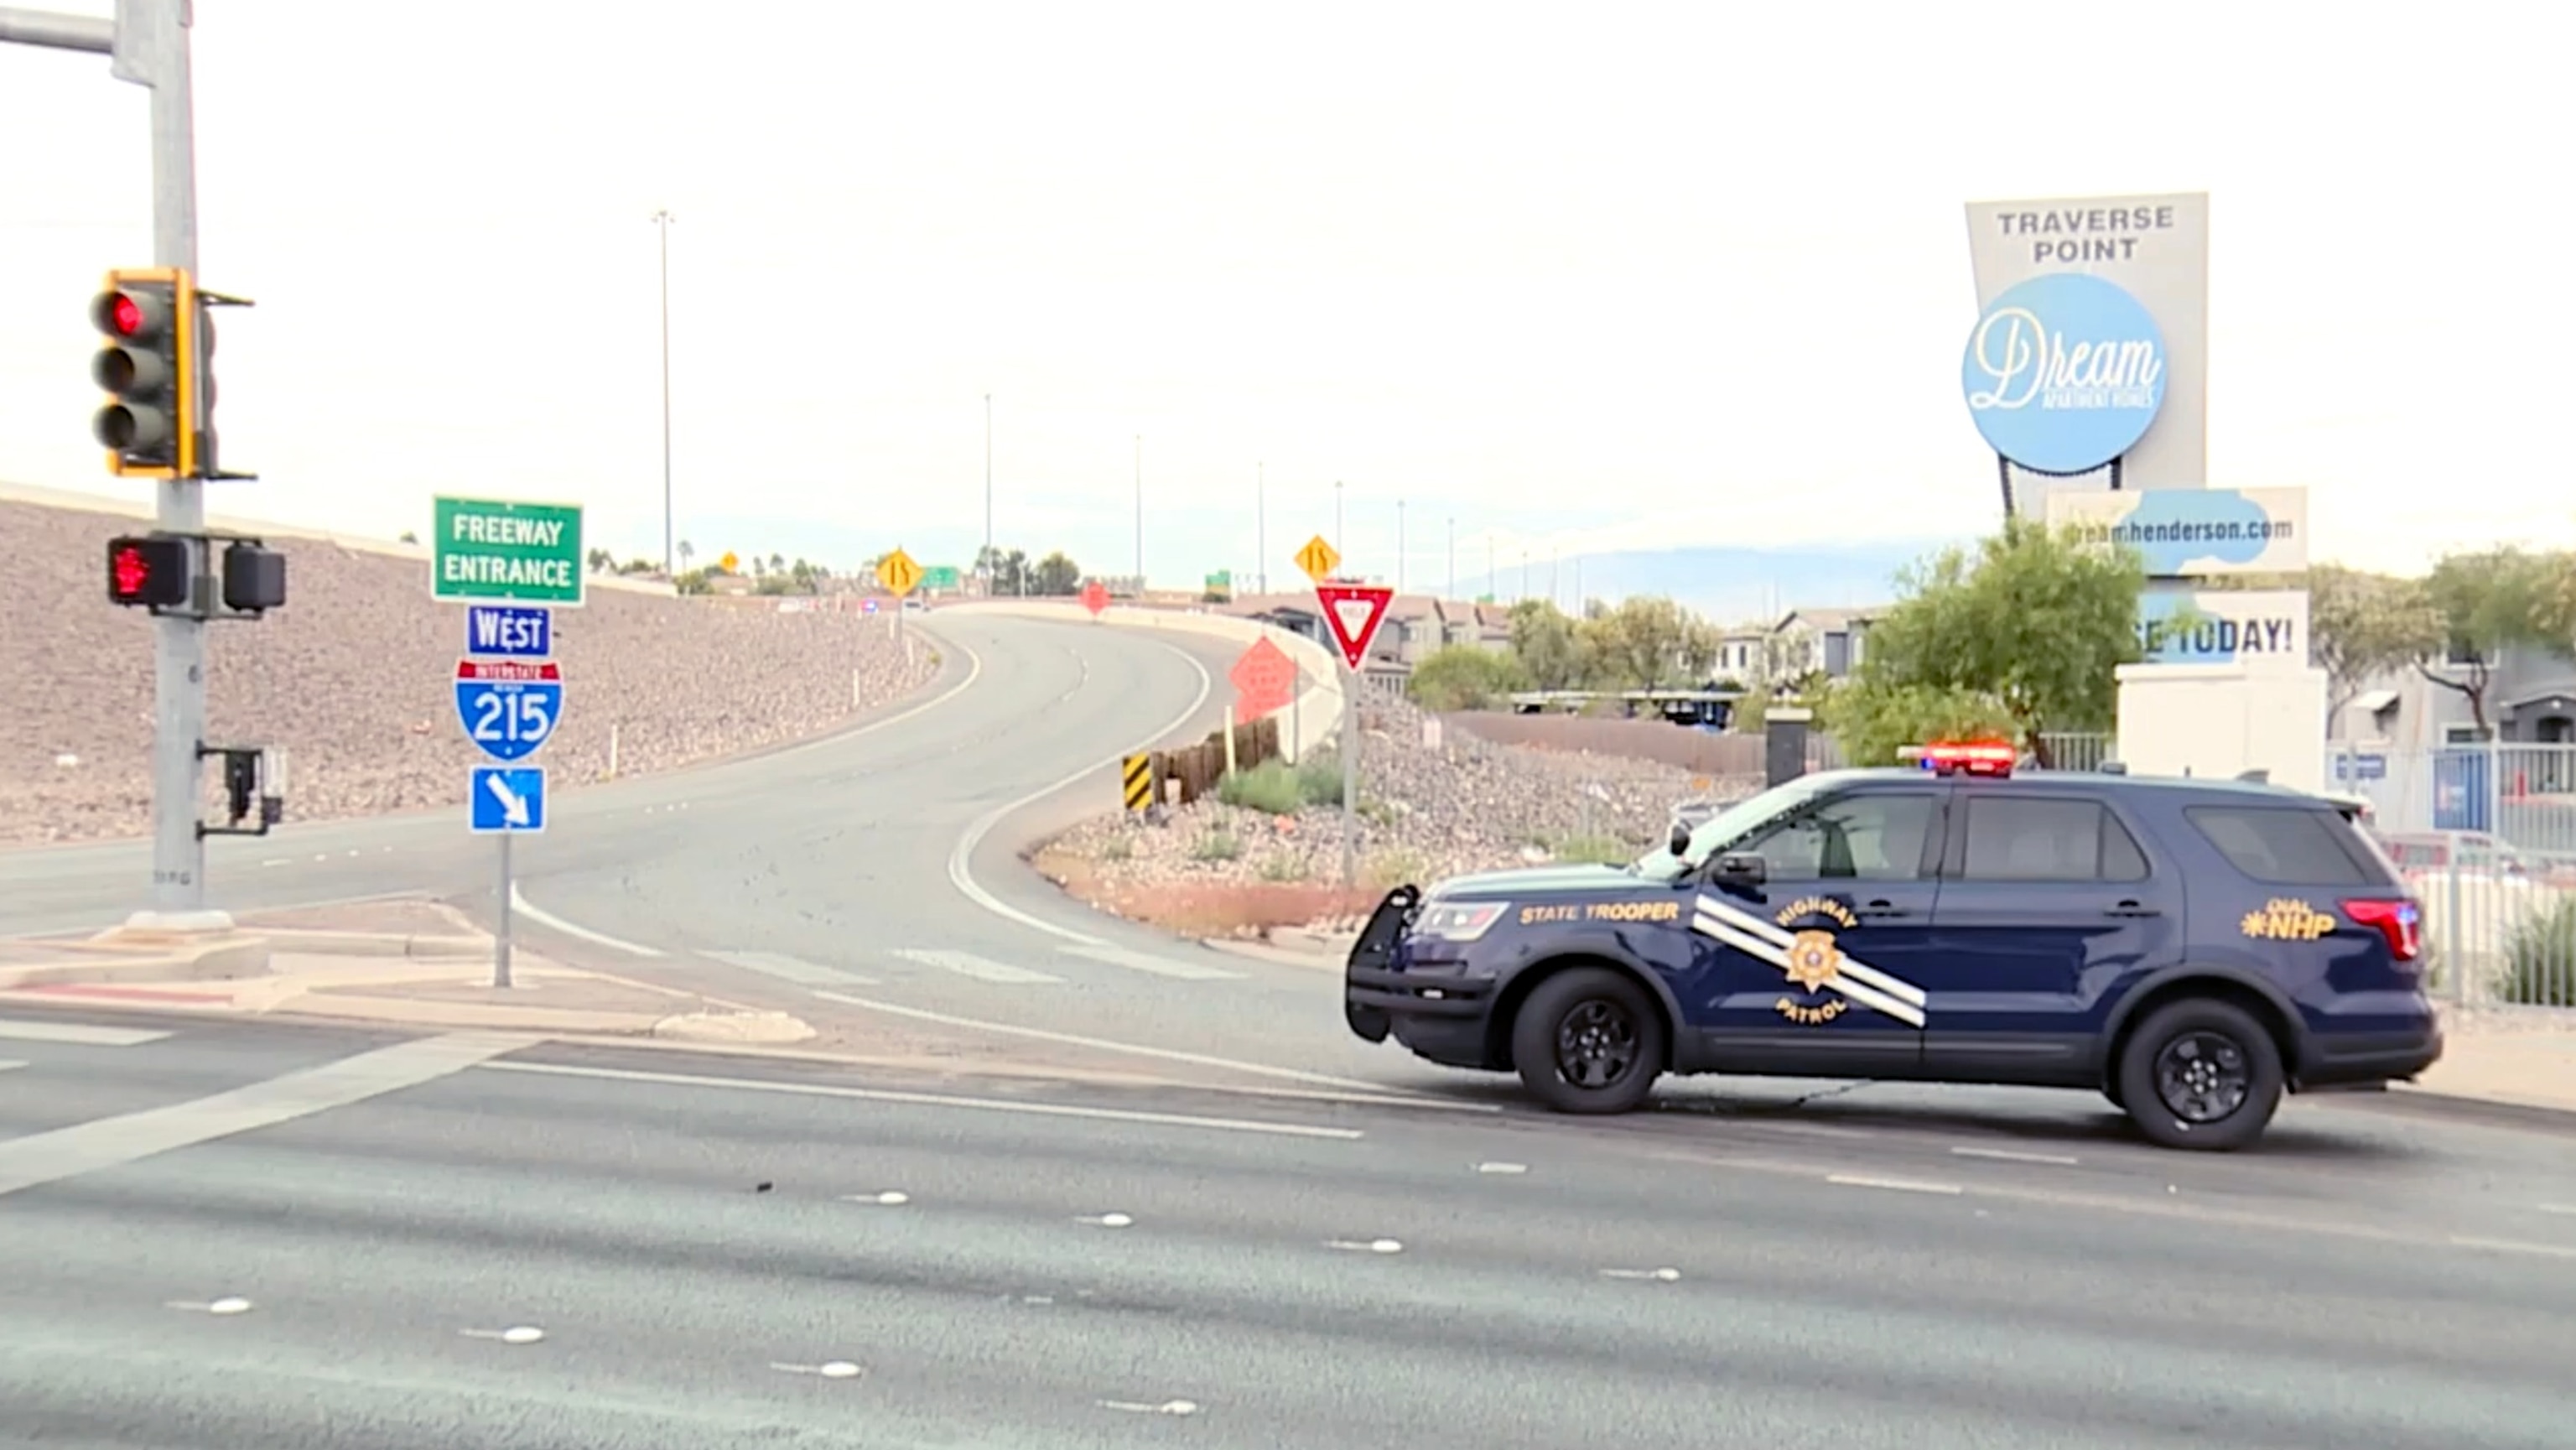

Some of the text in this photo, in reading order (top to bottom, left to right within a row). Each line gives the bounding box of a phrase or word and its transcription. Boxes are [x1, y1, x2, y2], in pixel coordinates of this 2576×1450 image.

[1997, 206, 2174, 235] TRAVERSE
[2034, 237, 2138, 263] POINT
[1969, 305, 2162, 409] Dream
[454, 513, 564, 546] FREEWAY
[2064, 520, 2293, 545] reamhenderson.com
[444, 553, 572, 587] ENTRANCE
[475, 608, 543, 649] WEST
[2174, 619, 2293, 654] TODAY!
[474, 691, 549, 742] 215
[1520, 902, 1679, 924] STATE TROOPER
[1775, 896, 1858, 928] HIGHWAY
[1775, 997, 1847, 1025] PATROL
